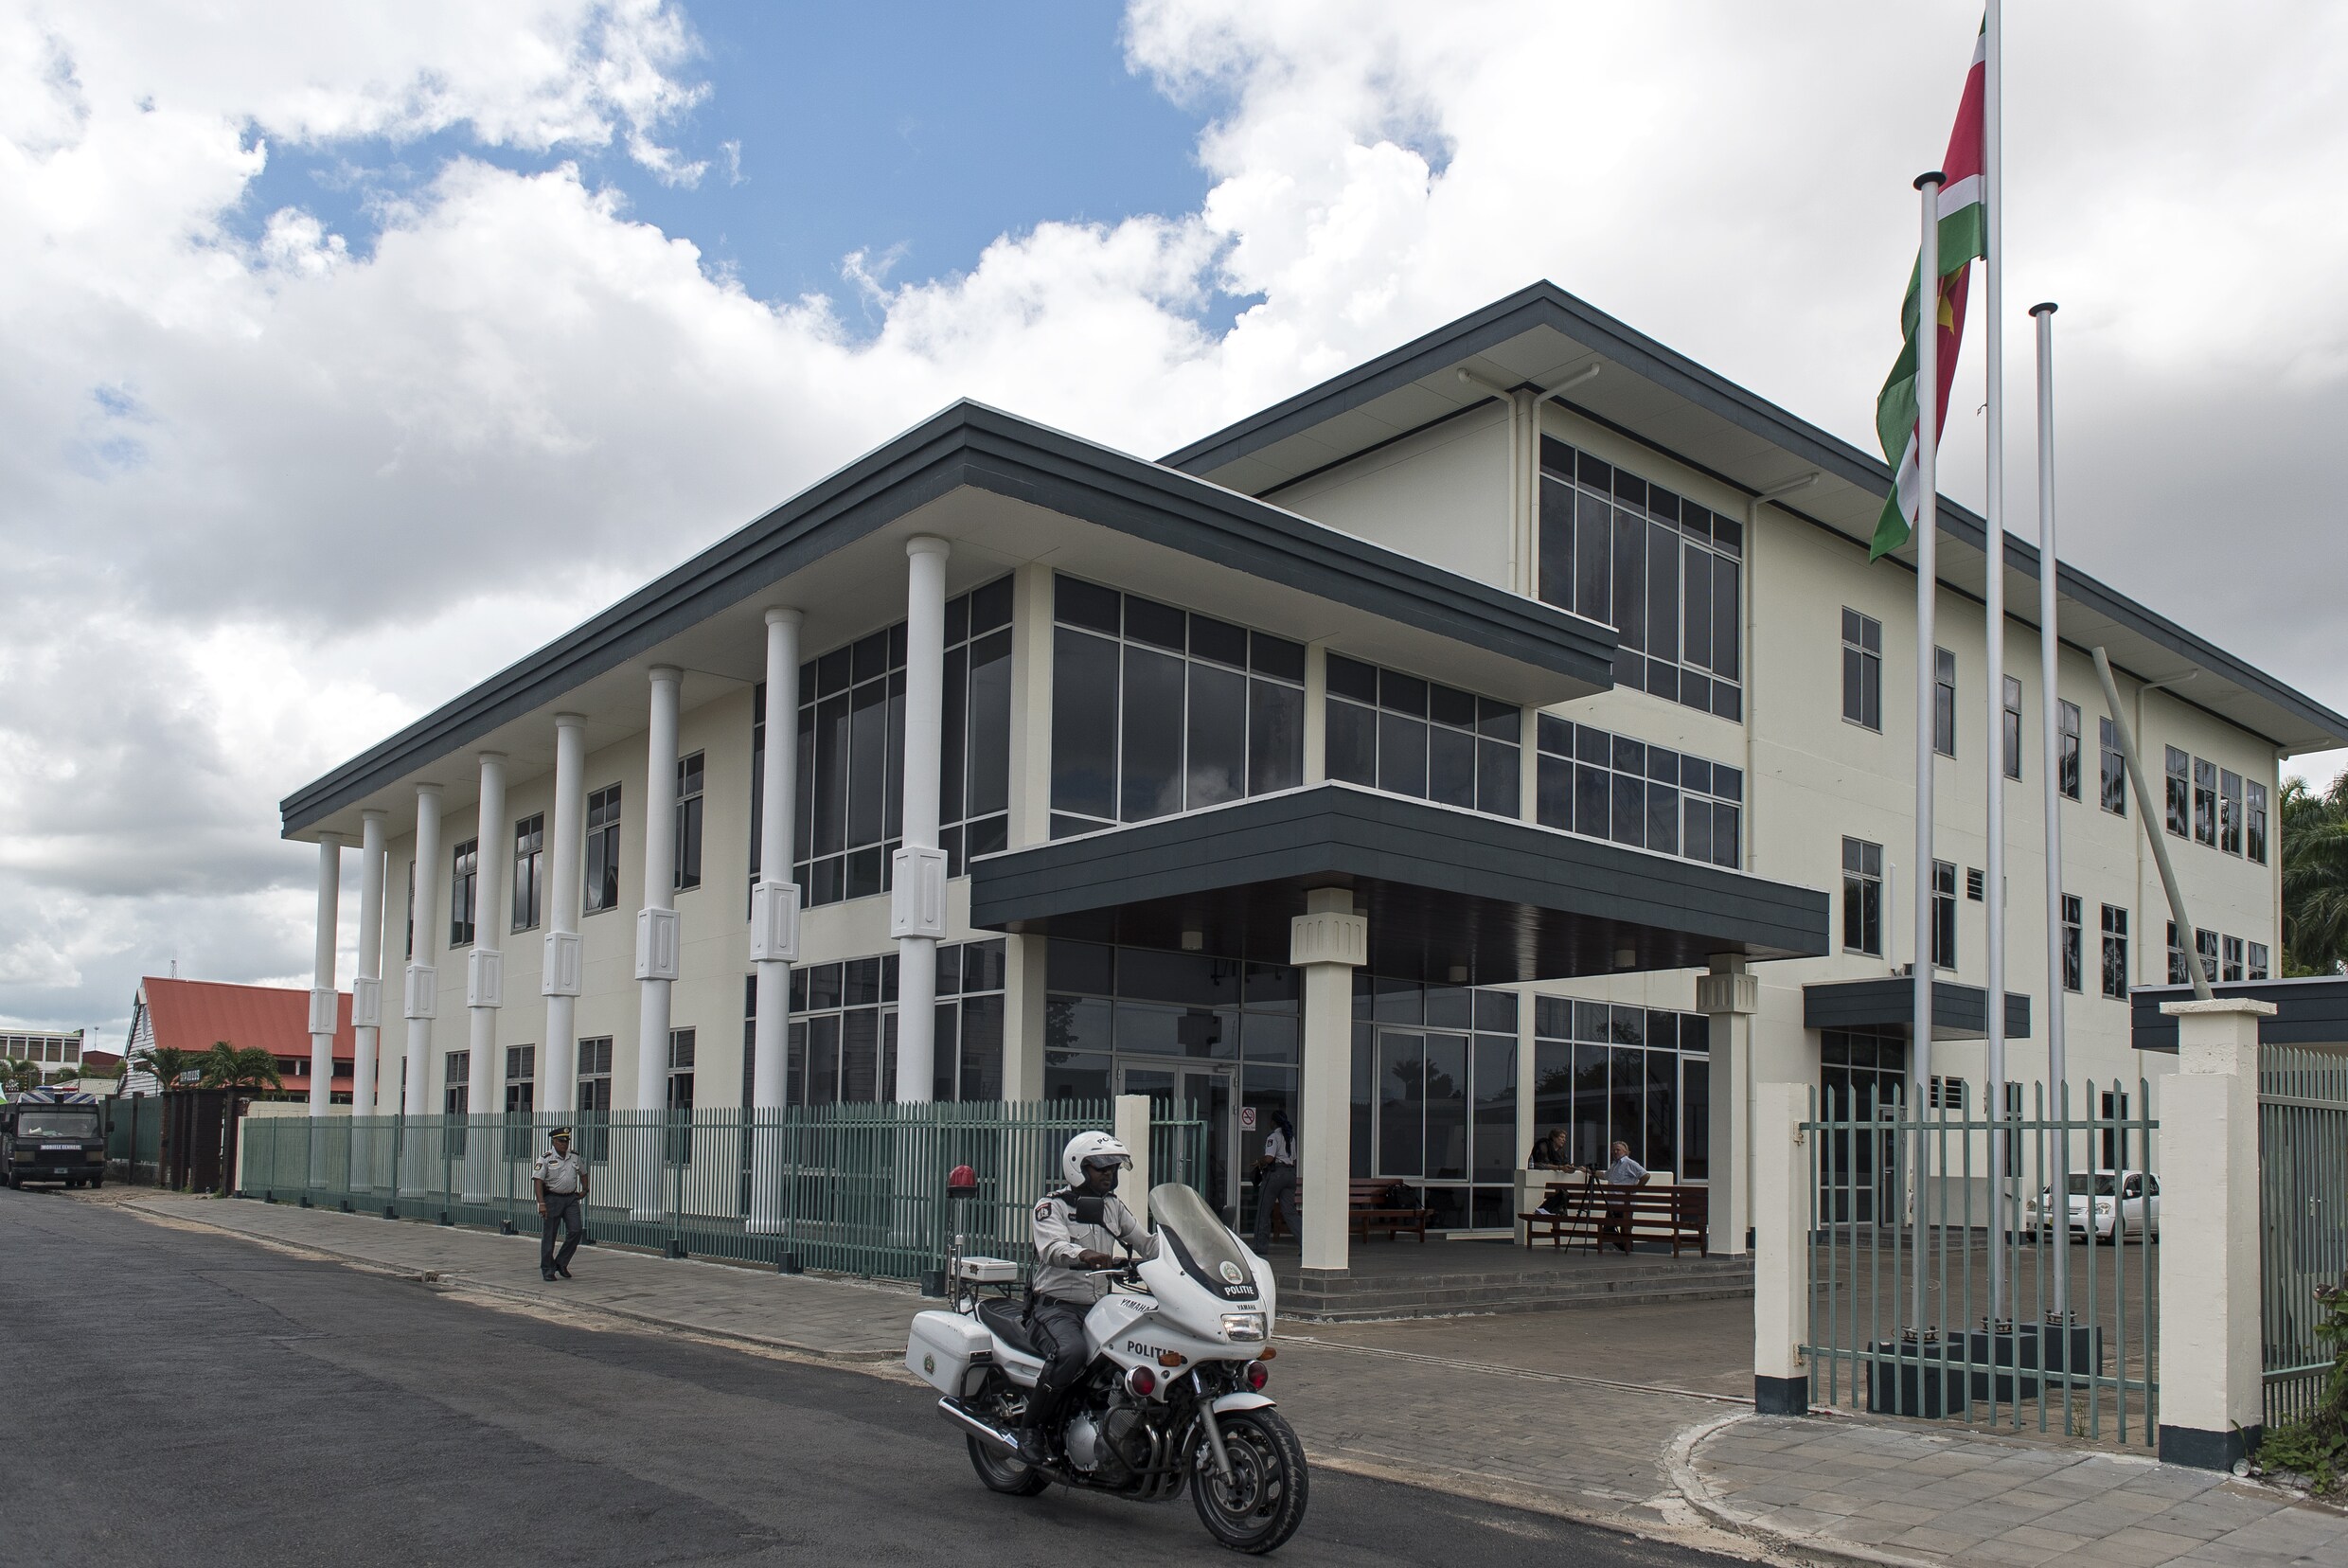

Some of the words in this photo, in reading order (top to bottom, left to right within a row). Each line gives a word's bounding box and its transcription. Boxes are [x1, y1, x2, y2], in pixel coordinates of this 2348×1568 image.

[1224, 1285, 1254, 1296] POLITIE
[1120, 1298, 1150, 1313] YAMAHA
[1128, 1340, 1175, 1359] POLIT
